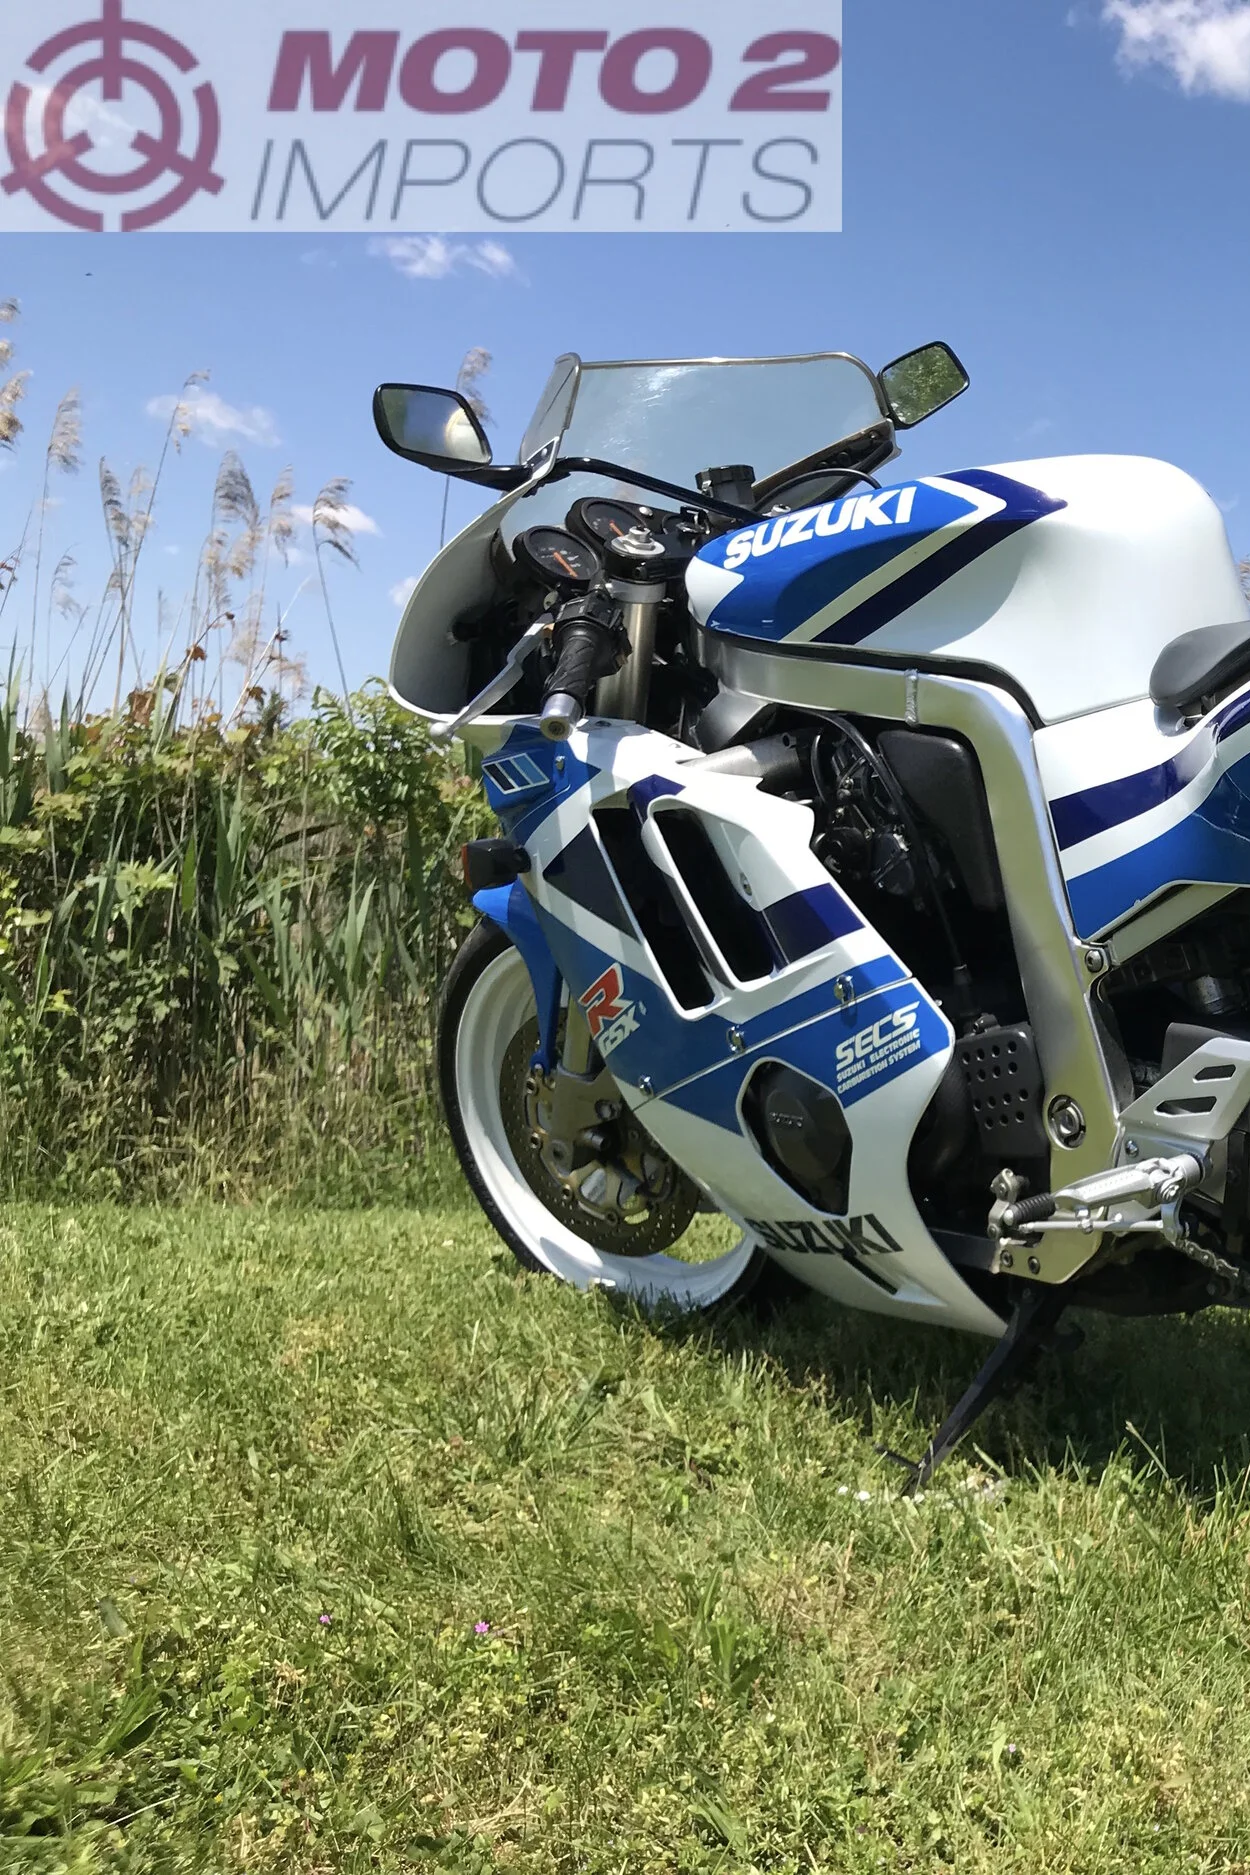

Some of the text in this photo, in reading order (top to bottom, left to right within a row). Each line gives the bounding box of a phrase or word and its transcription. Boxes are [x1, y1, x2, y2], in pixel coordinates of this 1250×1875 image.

[723, 486, 917, 570] SUZUKI
[578, 961, 635, 1041] R
[835, 1000, 920, 1071] SECS
[837, 1028, 920, 1082] SUZUKI ELECTRONIC
[888, 1039, 921, 1066] SYSTEM
[744, 1213, 904, 1256] SUZUKI
